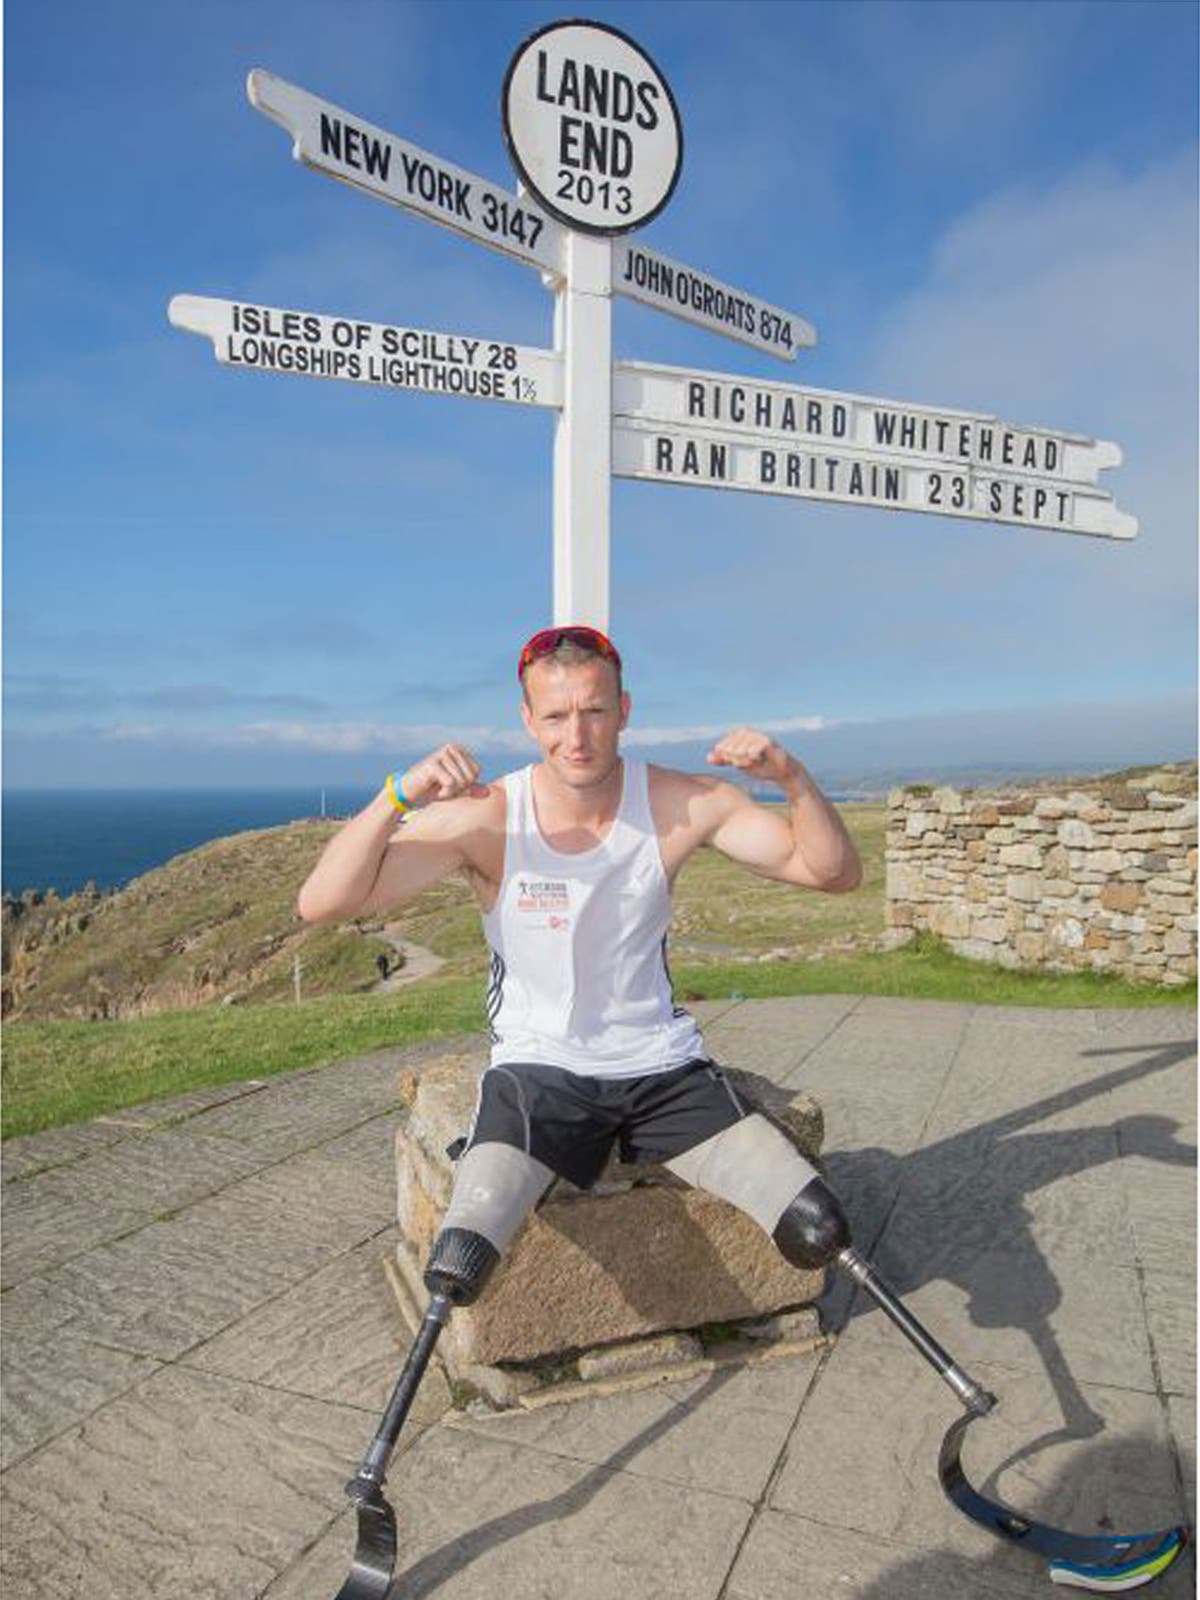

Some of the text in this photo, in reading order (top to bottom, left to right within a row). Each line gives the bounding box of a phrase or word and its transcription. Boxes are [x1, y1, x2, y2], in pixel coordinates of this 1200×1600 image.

[537, 50, 659, 130] LANDS
[320, 112, 543, 249] NEW YORK 3147
[560, 115, 633, 179] END
[556, 170, 632, 214] 2013
[624, 250, 674, 298] JOHN
[760, 310, 793, 350] 874
[228, 335, 361, 379] LONGSHIPS
[368, 355, 505, 398] LIGHTHOUSE
[332, 322, 371, 350] OF
[382, 329, 480, 364] SCILLY
[487, 343, 517, 370] 28
[688, 382, 1057, 471] RICHARD WHITEHEAD
[656, 437, 1069, 522] RAN BRITAIN 23 SEPT
